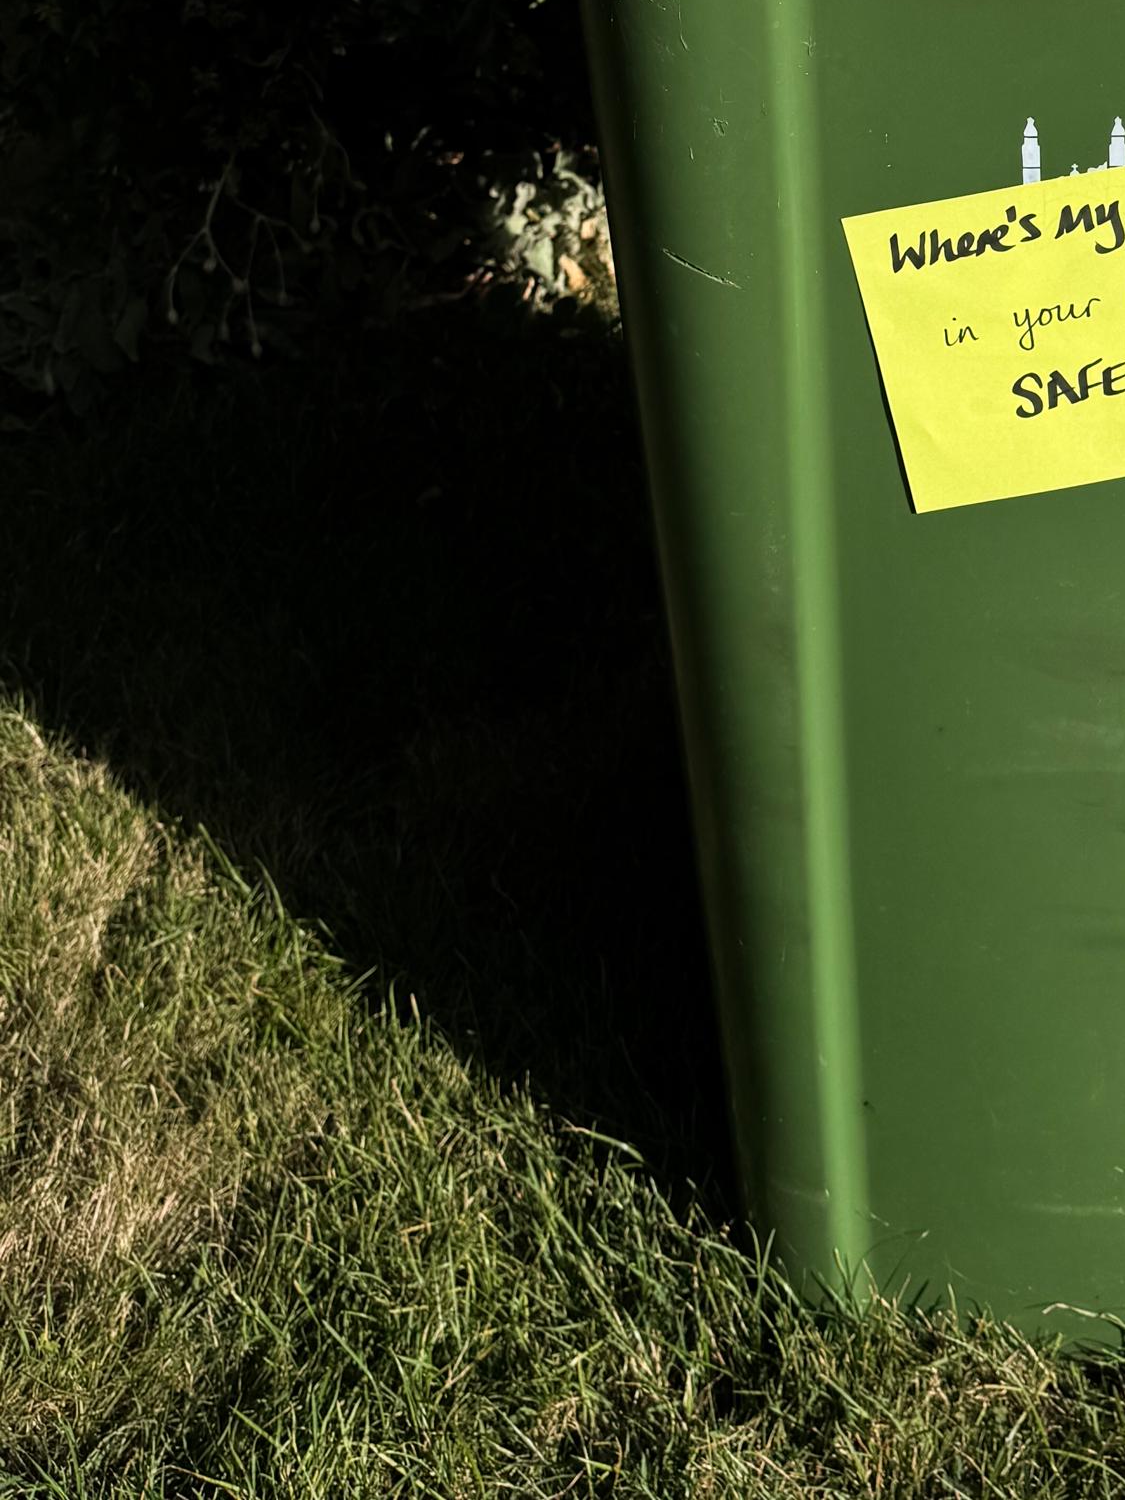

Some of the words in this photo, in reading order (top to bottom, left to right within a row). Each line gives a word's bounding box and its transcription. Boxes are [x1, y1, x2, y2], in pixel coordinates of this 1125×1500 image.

[889, 205, 1042, 274] Where's
[943, 315, 979, 347] in
[1012, 297, 1102, 351] your
